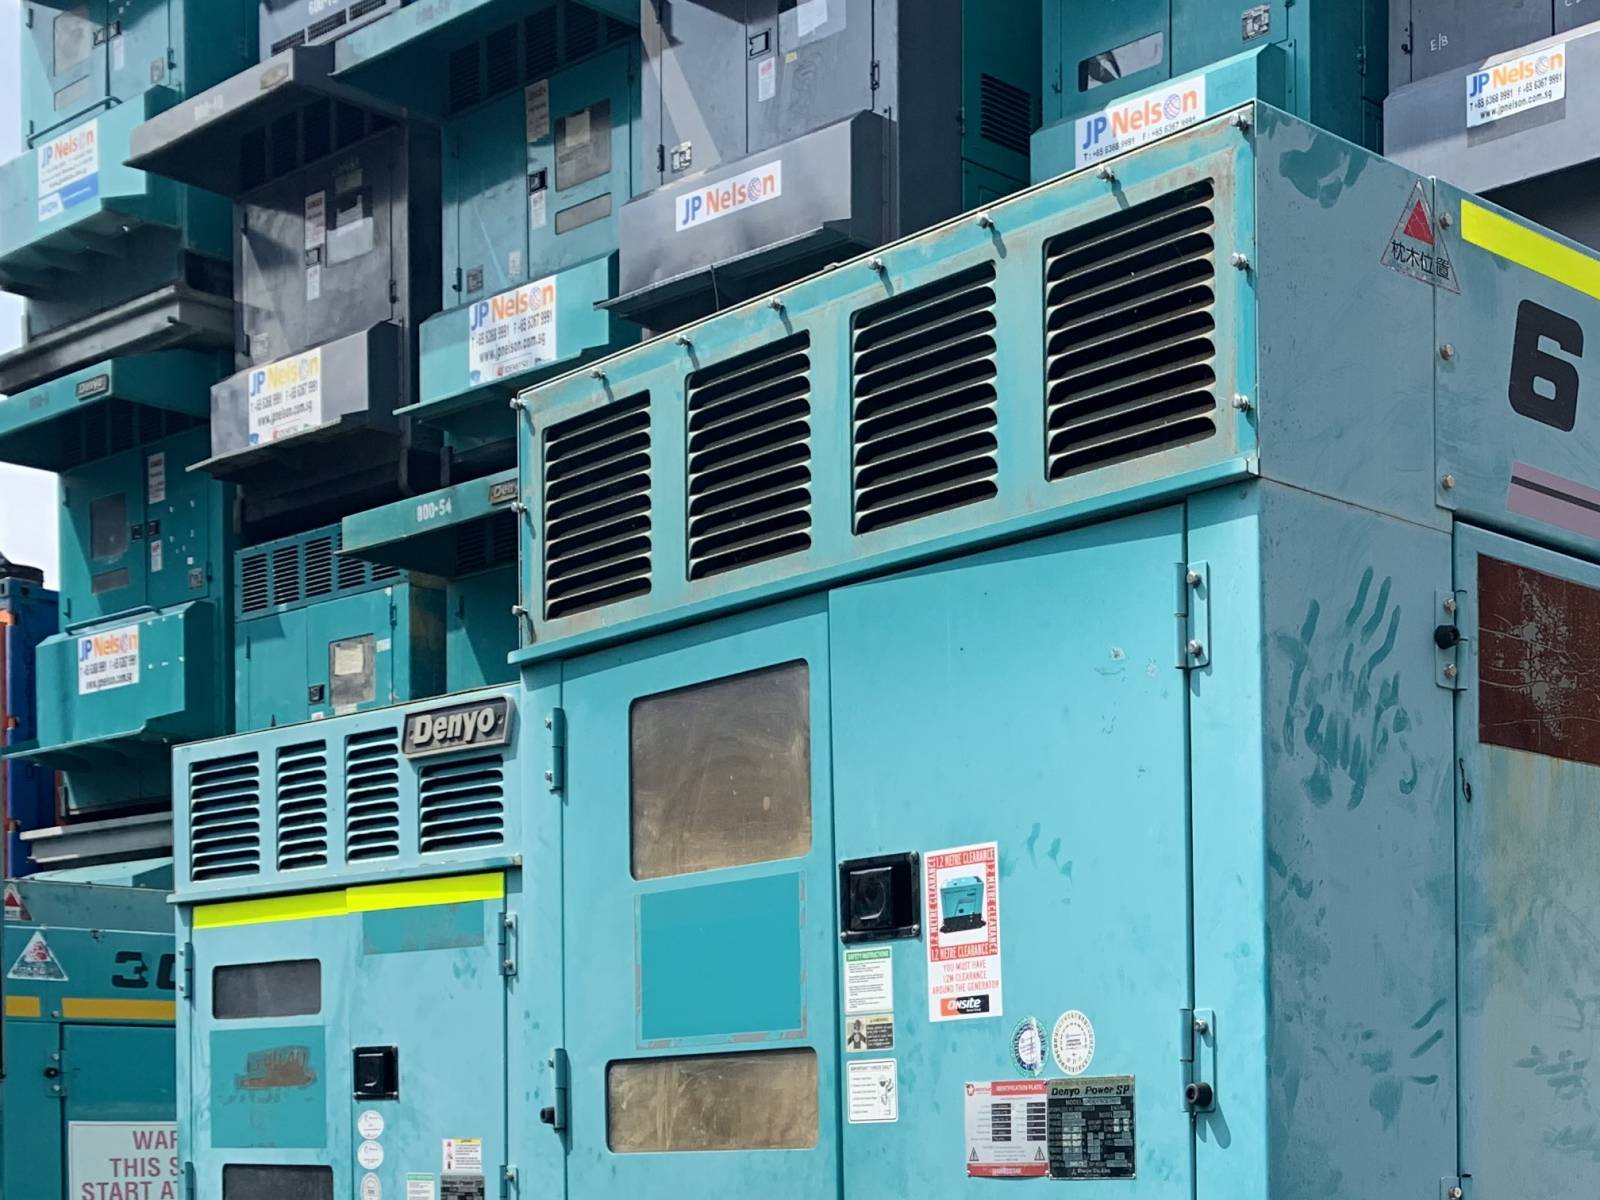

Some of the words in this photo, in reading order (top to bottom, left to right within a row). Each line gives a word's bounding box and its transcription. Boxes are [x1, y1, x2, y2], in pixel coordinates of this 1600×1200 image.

[1469, 73, 1490, 97] JP
[1491, 53, 1563, 89] Nelson
[1082, 116, 1107, 150] JP
[1111, 89, 1197, 138] Nelson
[682, 195, 702, 226] JP
[706, 174, 775, 216] Nelson
[471, 301, 489, 331] JP
[491, 284, 554, 323] Nelson
[251, 371, 266, 397] JP
[79, 639, 93, 662] JP
[413, 707, 495, 746] Denyo
[1051, 1087, 1080, 1096] Denyo
[1085, 1086, 1114, 1095] Power
[1116, 1085, 1130, 1095] SP
[109, 1157, 160, 1178] THIS
